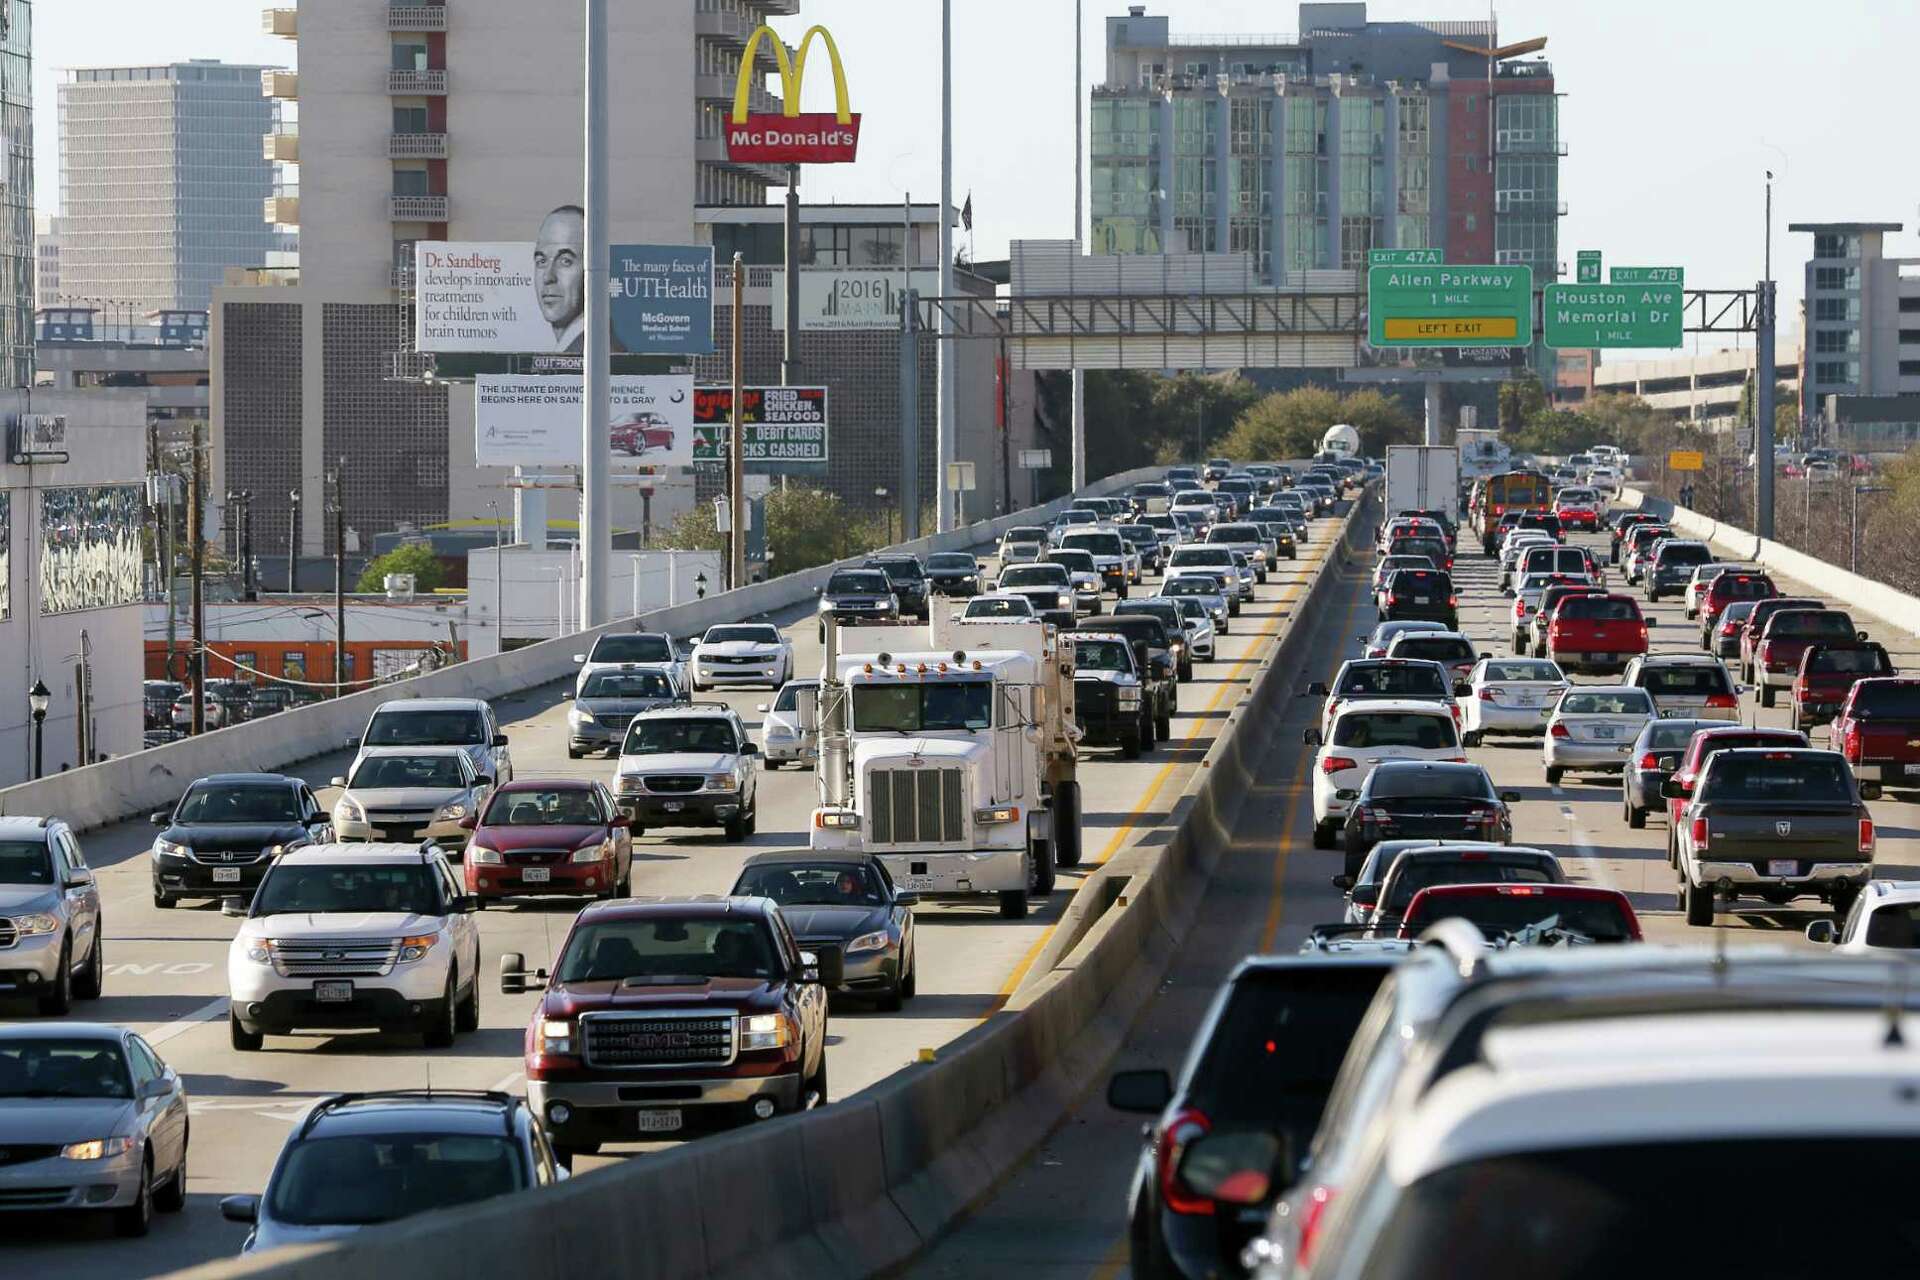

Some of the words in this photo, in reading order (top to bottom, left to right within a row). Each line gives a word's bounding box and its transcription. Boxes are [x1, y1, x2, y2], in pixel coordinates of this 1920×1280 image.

[731, 131, 854, 146] McDonald's
[425, 252, 444, 268] Dr.
[447, 252, 501, 274] Sandberg
[1373, 253, 1396, 262] EXIT
[1406, 251, 1437, 263] 47A
[621, 258, 640, 272] The
[643, 263, 670, 276] many
[672, 259, 696, 272] faces
[697, 259, 709, 272] of
[425, 269, 472, 291] develops
[475, 272, 532, 286] innovative
[1388, 274, 1432, 286] Allen
[1440, 273, 1513, 289] Parkway
[1615, 271, 1640, 280] EXIT
[1647, 269, 1679, 281] 47B
[841, 280, 882, 298] 2016
[425, 292, 484, 303] treatments
[1431, 294, 1437, 305] 1
[1444, 294, 1470, 304] MILE
[1556, 292, 1626, 304] Houston
[1640, 292, 1673, 304] Ave
[425, 305, 440, 321] for
[443, 304, 489, 322] children
[491, 306, 518, 322] with
[641, 312, 691, 323] McGovern
[1557, 310, 1637, 324] Memorial
[1650, 311, 1670, 323] Dr
[425, 322, 455, 338] brain
[457, 326, 498, 339] tumors
[1418, 324, 1447, 334] LEFT
[1455, 323, 1482, 333] EXIT
[1595, 330, 1600, 341] 1
[1607, 332, 1633, 341] MILE
[481, 385, 499, 393] THE
[501, 385, 546, 393] ULTIMATE
[481, 395, 516, 404] BEGINS
[518, 395, 542, 404] HERE
[544, 395, 558, 404] ON
[560, 395, 579, 404] SAN
[631, 396, 655, 405] GRAY
[764, 391, 797, 400] FRIED
[764, 411, 821, 422] SEAFOOD
[756, 427, 785, 441] DEBIT
[787, 427, 822, 440] CARDS
[716, 443, 766, 457] CCKS
[769, 443, 820, 457] CASHED
